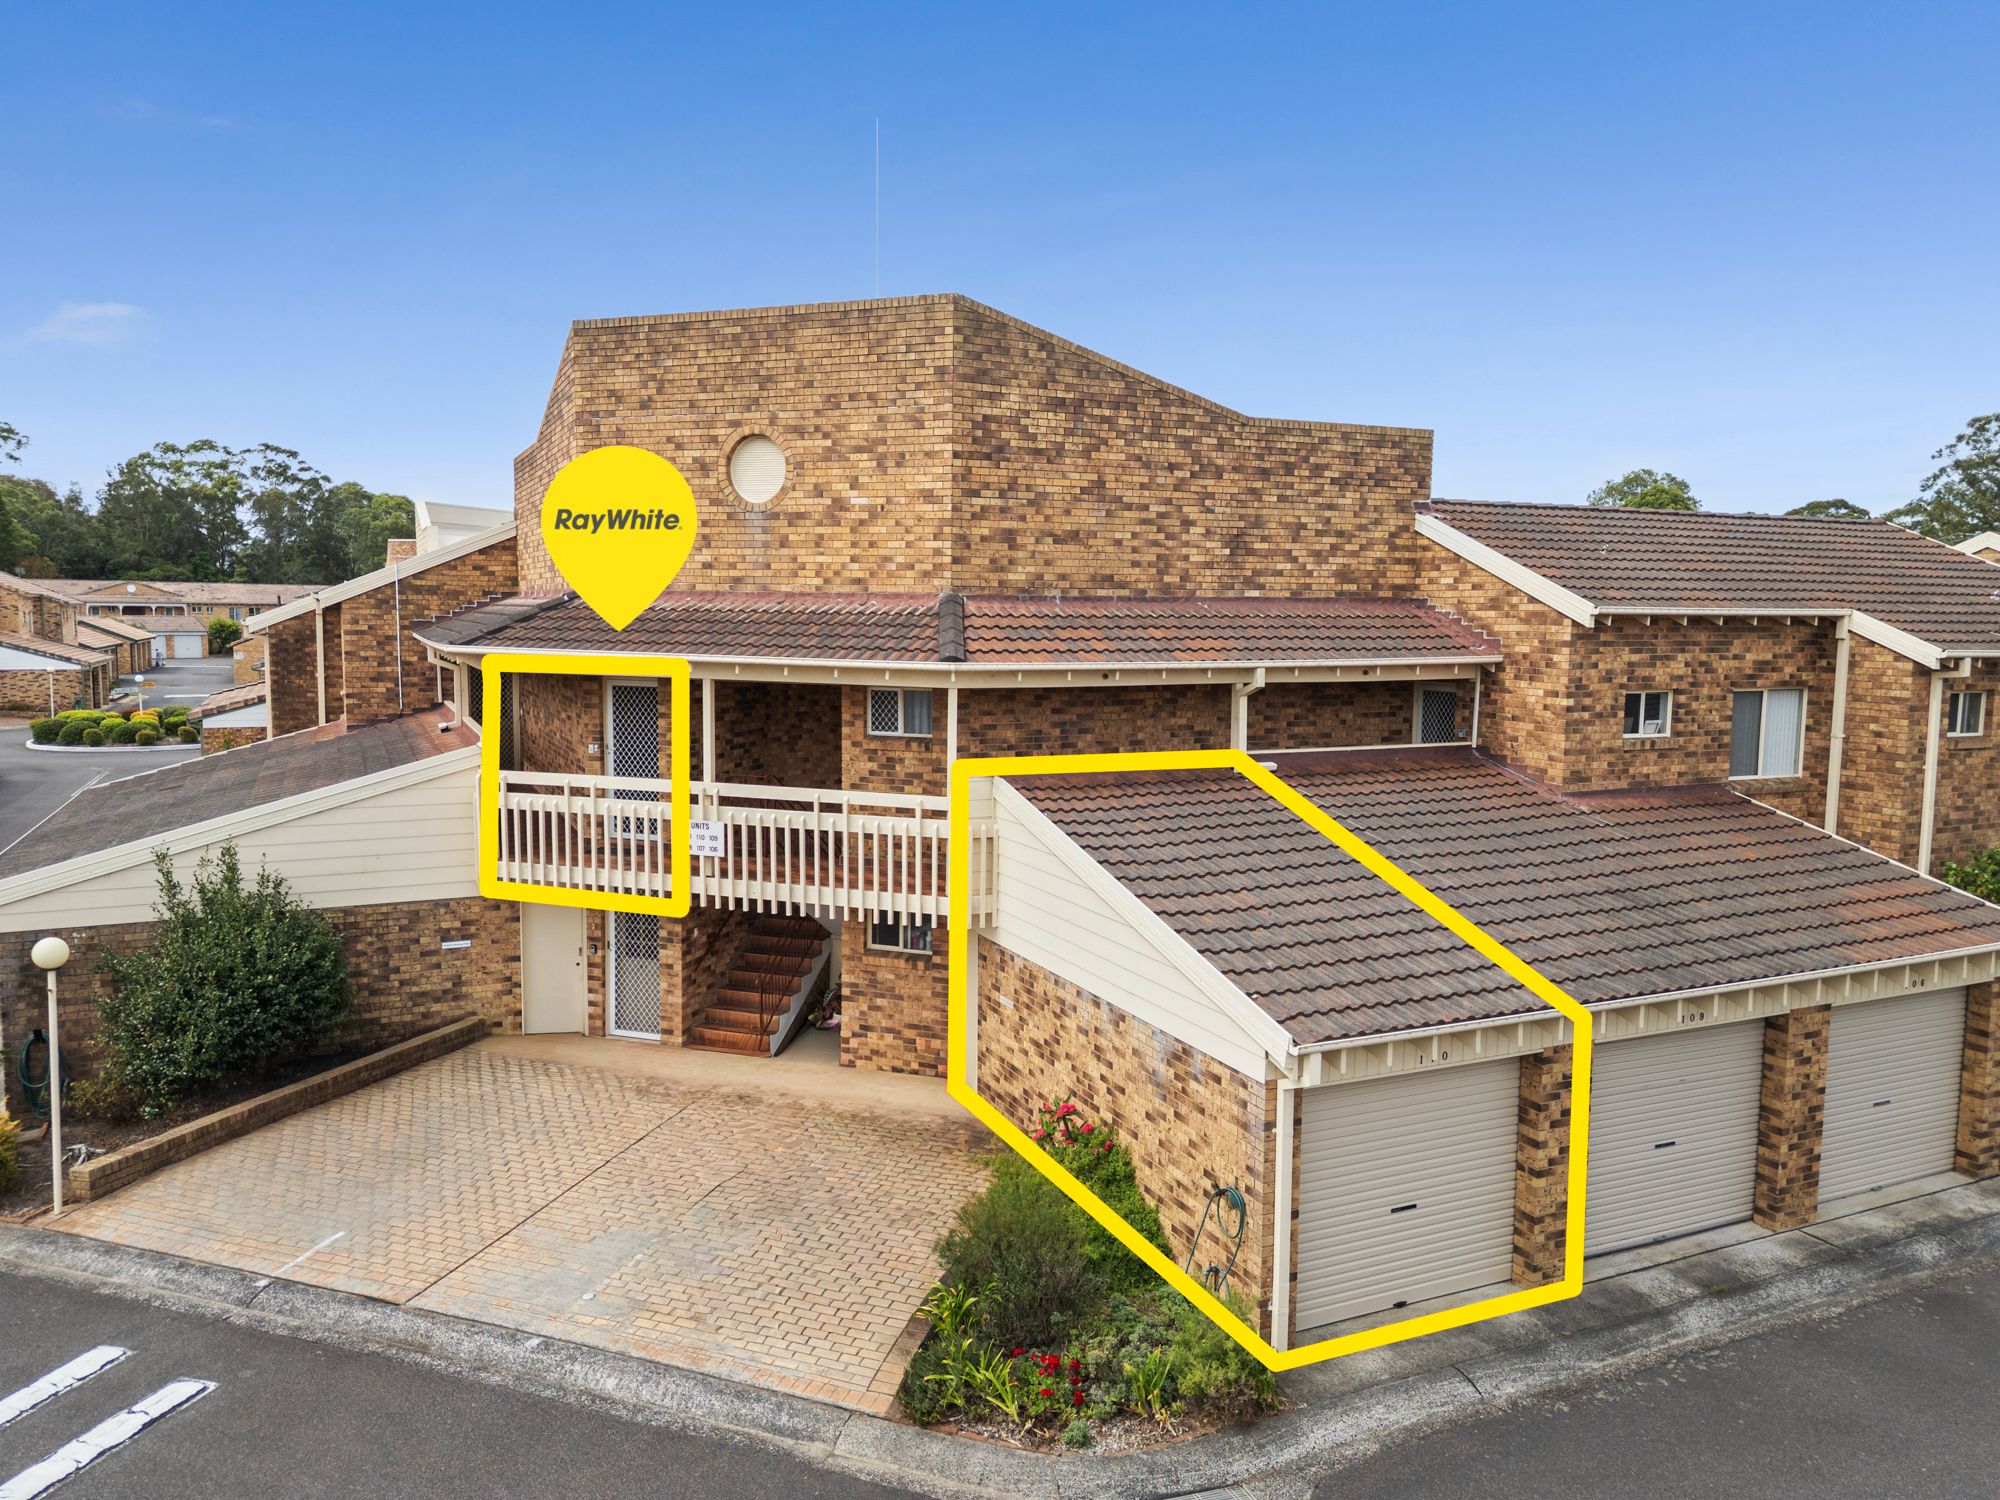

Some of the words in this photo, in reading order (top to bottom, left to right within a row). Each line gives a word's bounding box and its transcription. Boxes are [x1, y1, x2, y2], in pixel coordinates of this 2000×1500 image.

[690, 822, 710, 830] UNITS
[1681, 1011, 1705, 1024] 109
[1420, 1050, 1449, 1065] 10
